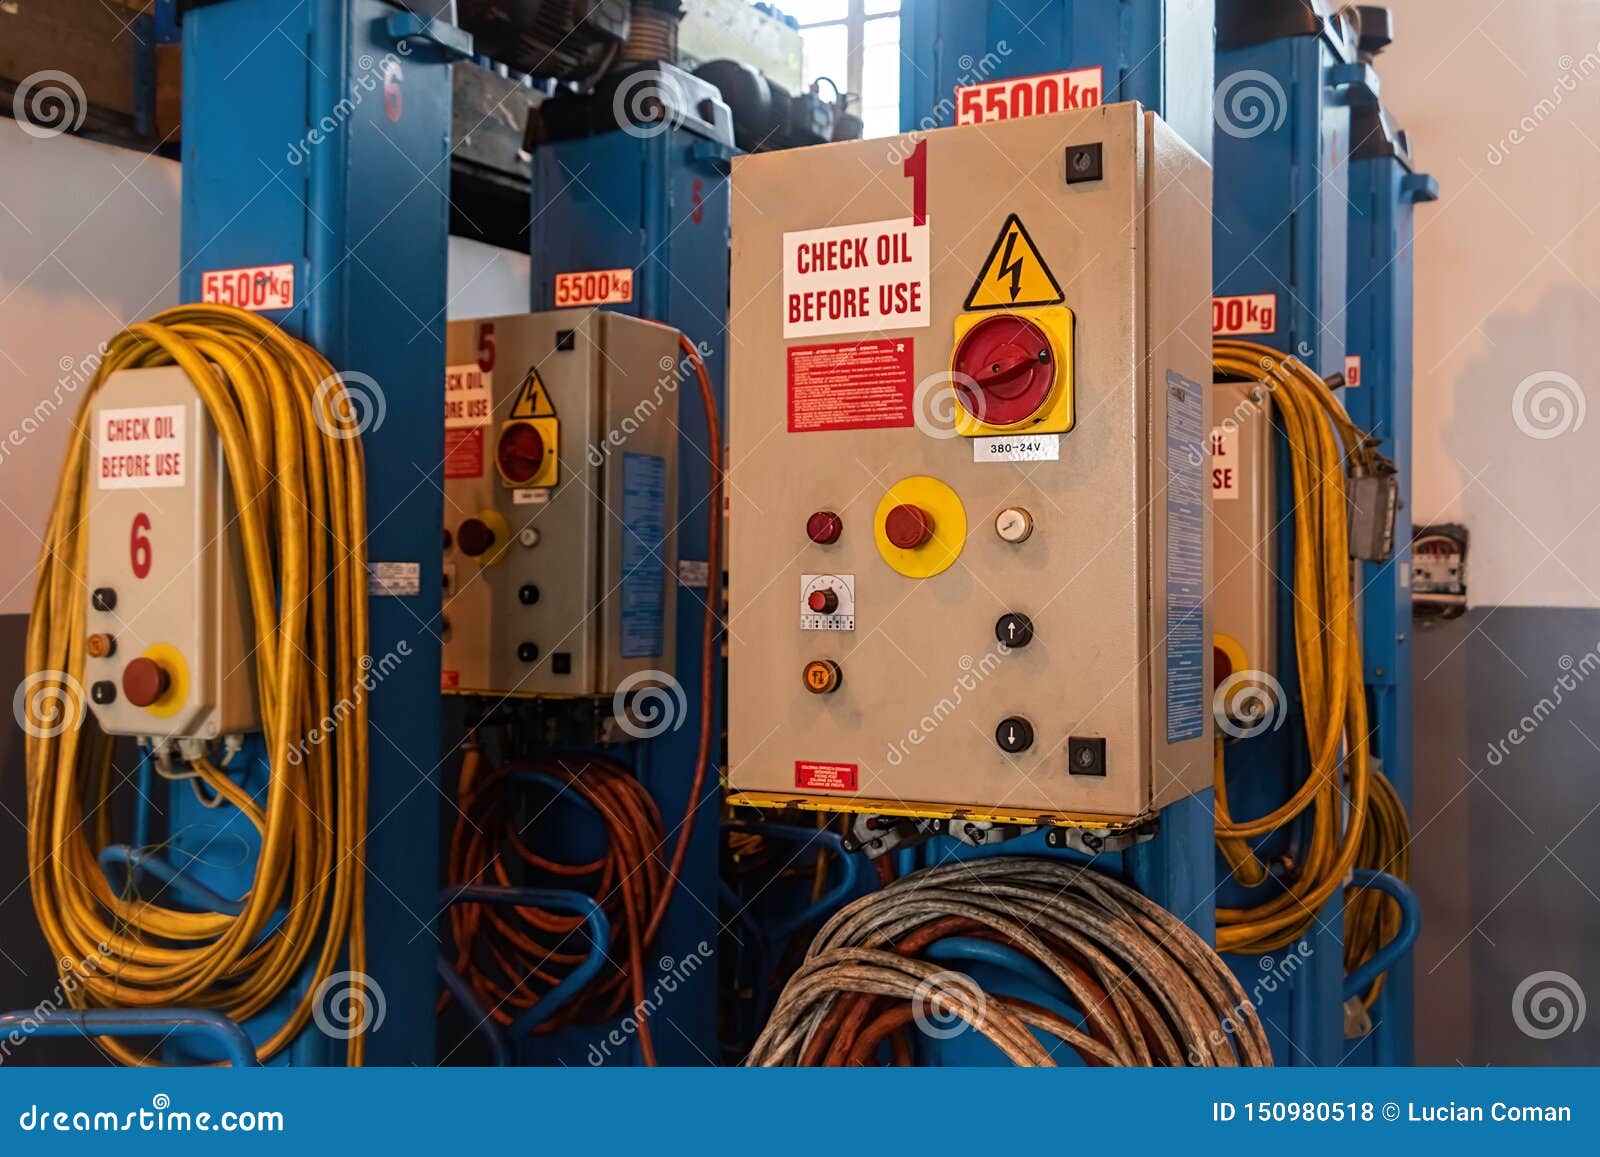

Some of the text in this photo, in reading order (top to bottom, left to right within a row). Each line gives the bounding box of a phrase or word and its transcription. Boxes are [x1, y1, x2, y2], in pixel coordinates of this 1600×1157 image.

[904, 138, 927, 227] 1
[796, 232, 912, 275] CHECK OIL
[558, 273, 631, 303] 5500kg
[788, 281, 922, 324] BEFORE USE
[477, 322, 496, 373] 5
[107, 416, 176, 442] CHECK OIL
[990, 443, 1041, 454] 380-24V
[102, 453, 181, 478] BEFORE USE
[130, 512, 152, 580] 6
